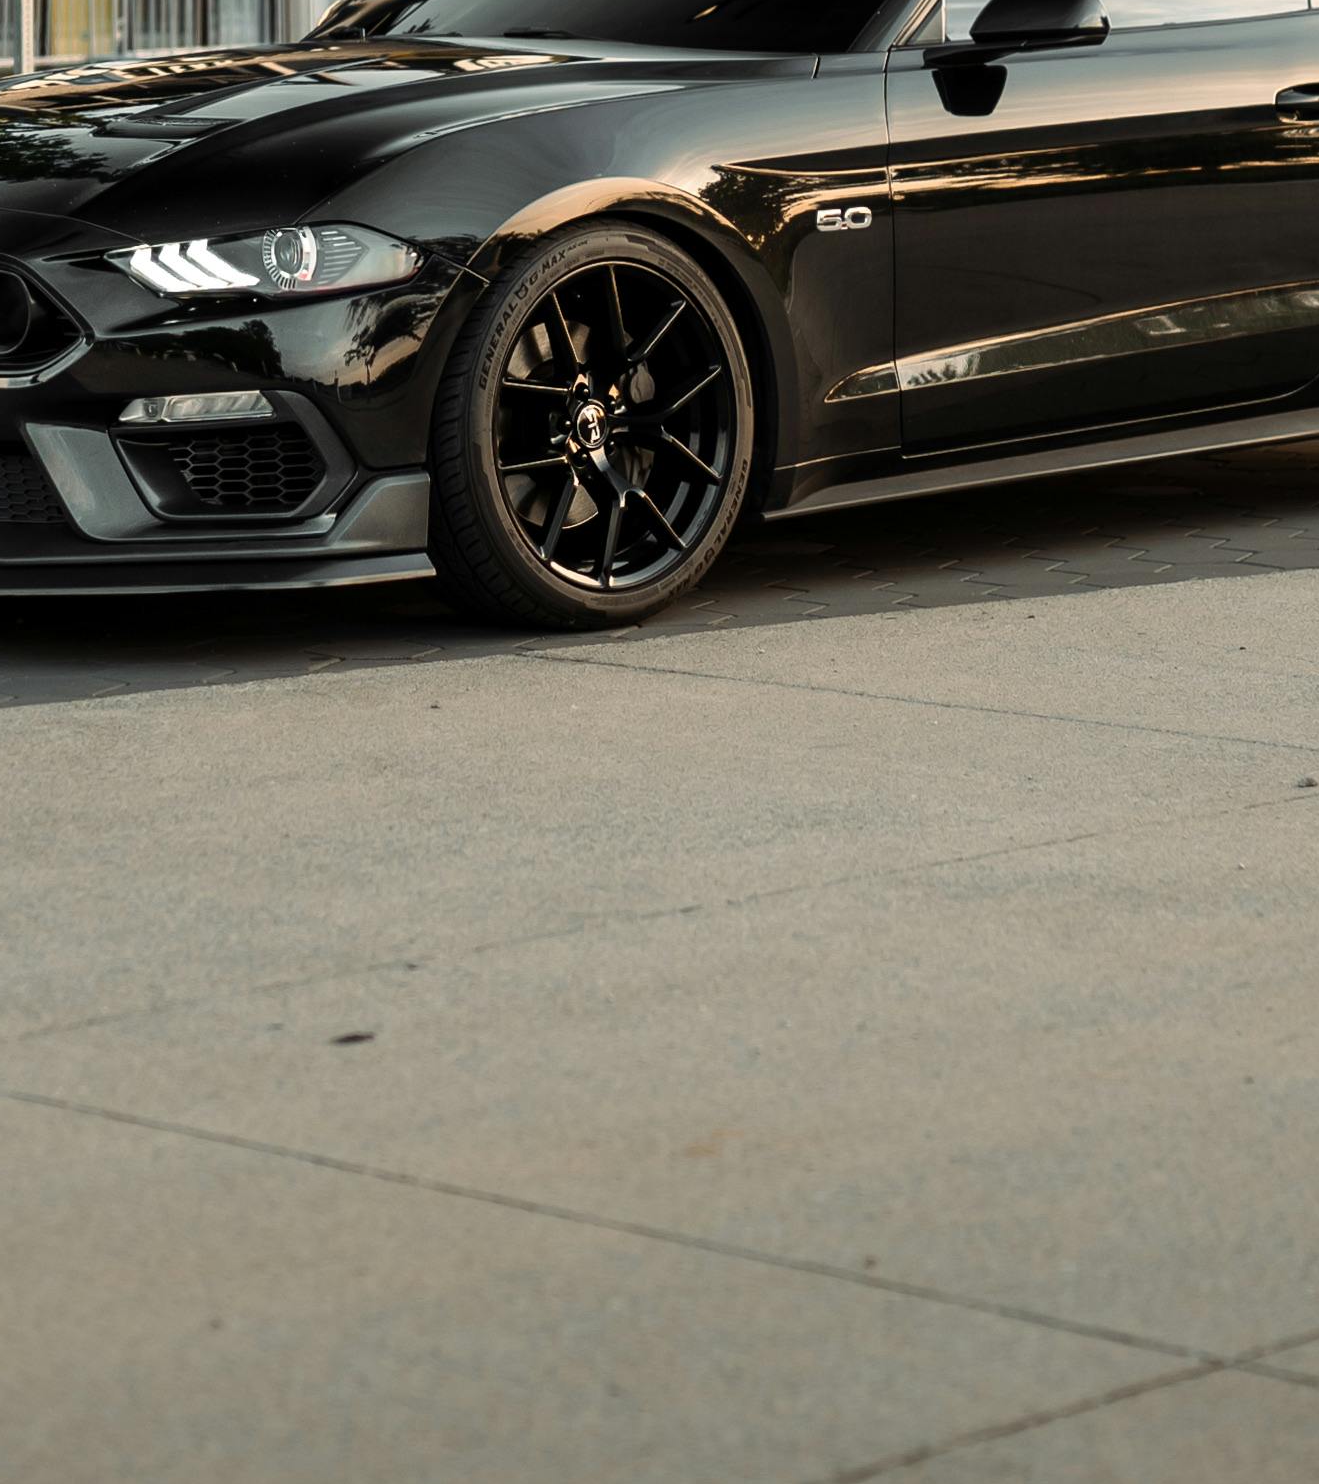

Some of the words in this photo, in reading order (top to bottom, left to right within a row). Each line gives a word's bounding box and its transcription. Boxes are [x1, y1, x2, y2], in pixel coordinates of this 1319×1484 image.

[817, 206, 873, 232] 5.0
[480, 301, 518, 391] GENERAL
[713, 458, 749, 546] GENERAL
